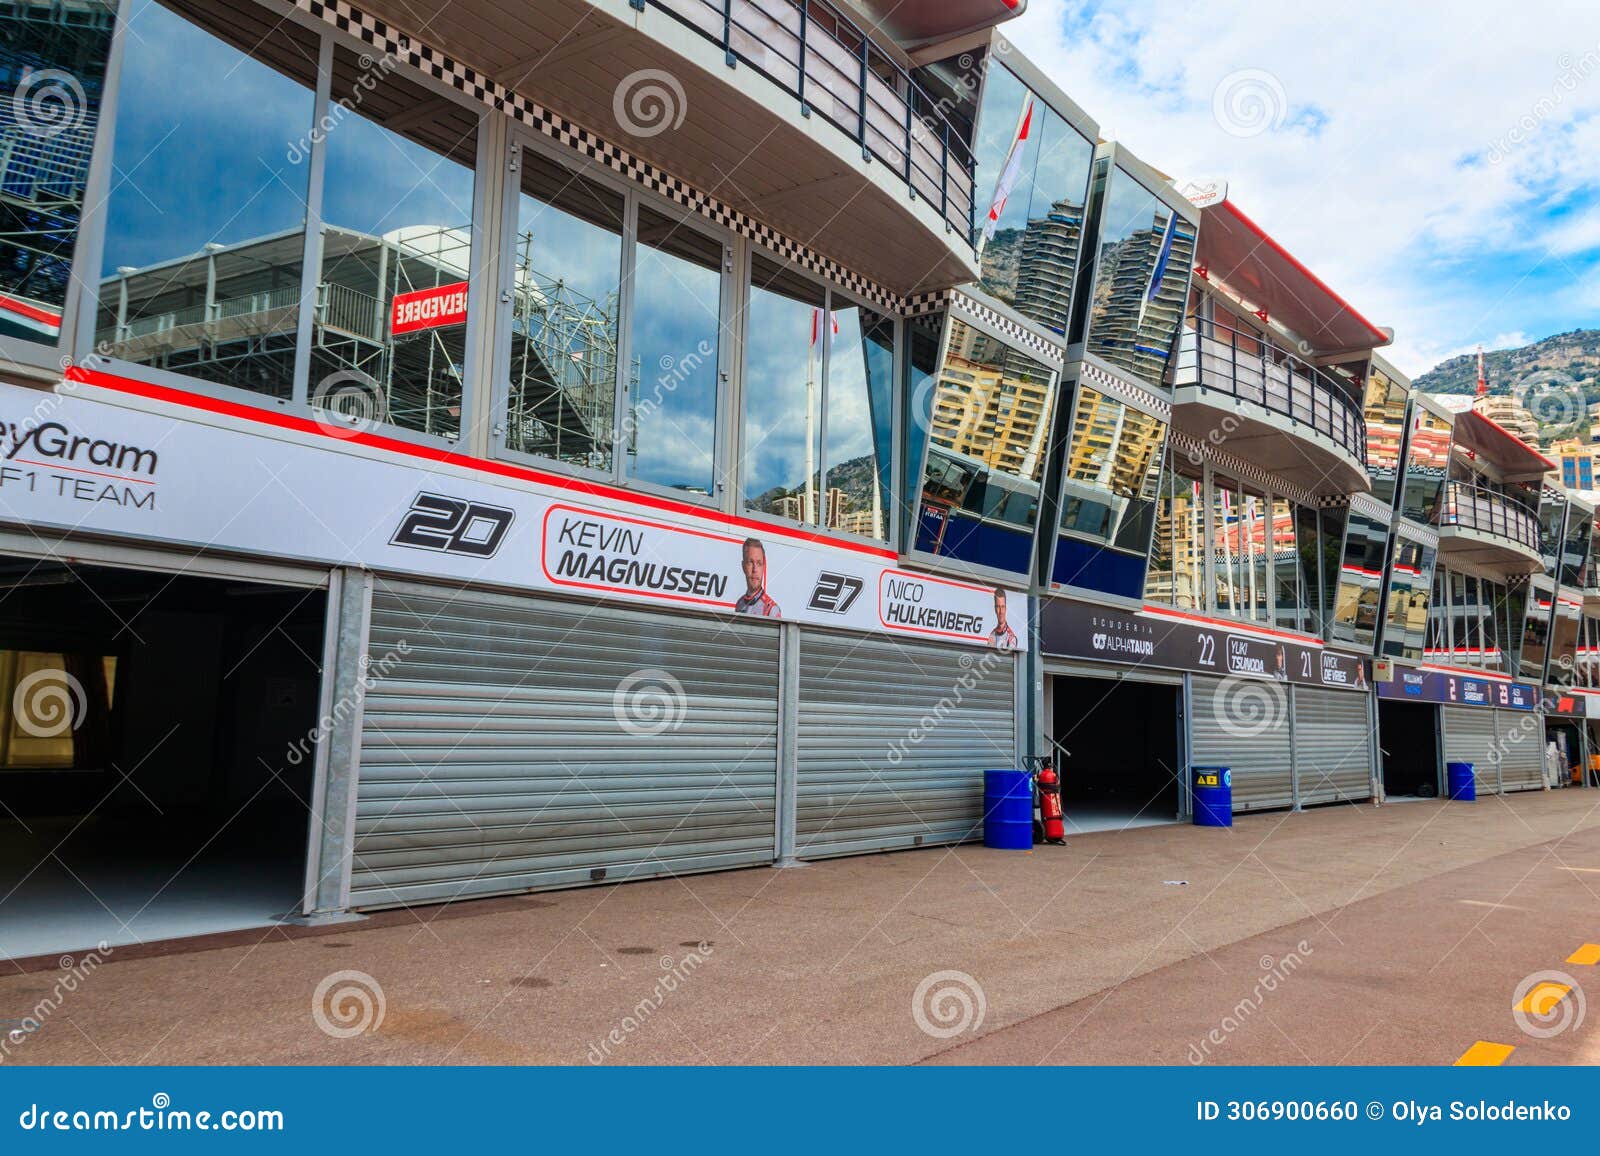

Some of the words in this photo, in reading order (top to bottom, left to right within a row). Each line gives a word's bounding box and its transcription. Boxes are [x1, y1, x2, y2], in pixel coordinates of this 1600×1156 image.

[0, 467, 35, 492] F1
[52, 474, 155, 511] TEAM
[387, 490, 516, 560] 20
[558, 517, 644, 555] KEVIN
[556, 549, 728, 598] MAGNUSSEN
[806, 569, 864, 615] 27
[887, 578, 924, 603] NICO
[887, 602, 983, 634] HULKENBERG
[1092, 617, 1153, 634] SCUDERIA
[1106, 633, 1154, 656] ALPHATAURI
[1197, 633, 1216, 666] 22
[1231, 640, 1249, 656] YUKI
[1231, 655, 1265, 673] TSUNODA
[1300, 651, 1312, 678] 21
[1449, 678, 1457, 701] 2
